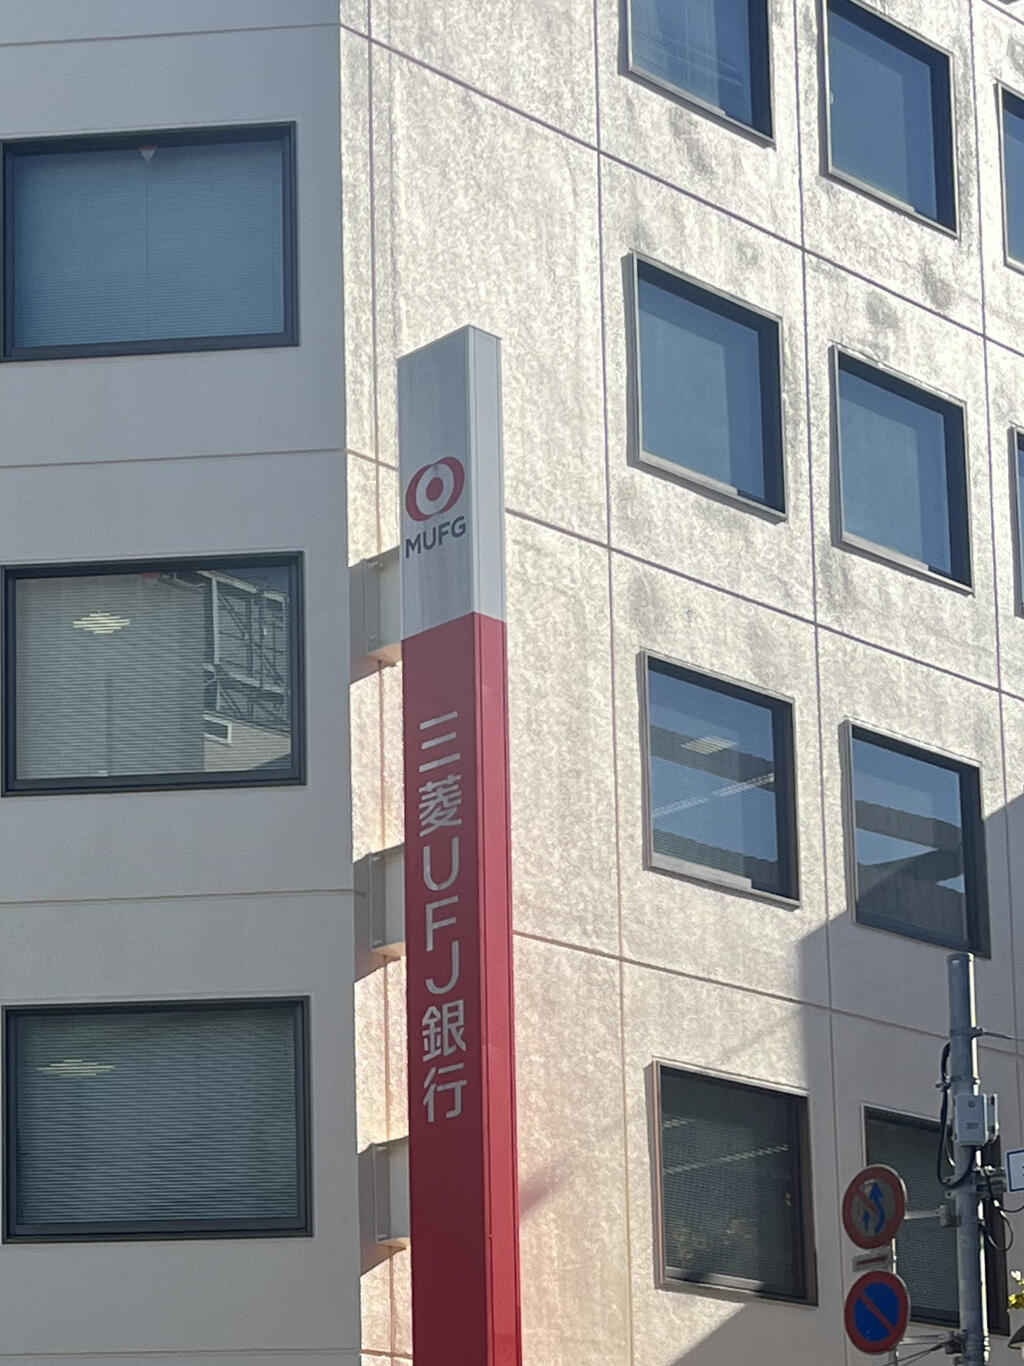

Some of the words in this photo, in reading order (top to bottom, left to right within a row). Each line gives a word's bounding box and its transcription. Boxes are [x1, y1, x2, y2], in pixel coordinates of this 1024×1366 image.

[405, 516, 466, 559] MUFG
[419, 711, 467, 1123] 三菱UFJ銀行
